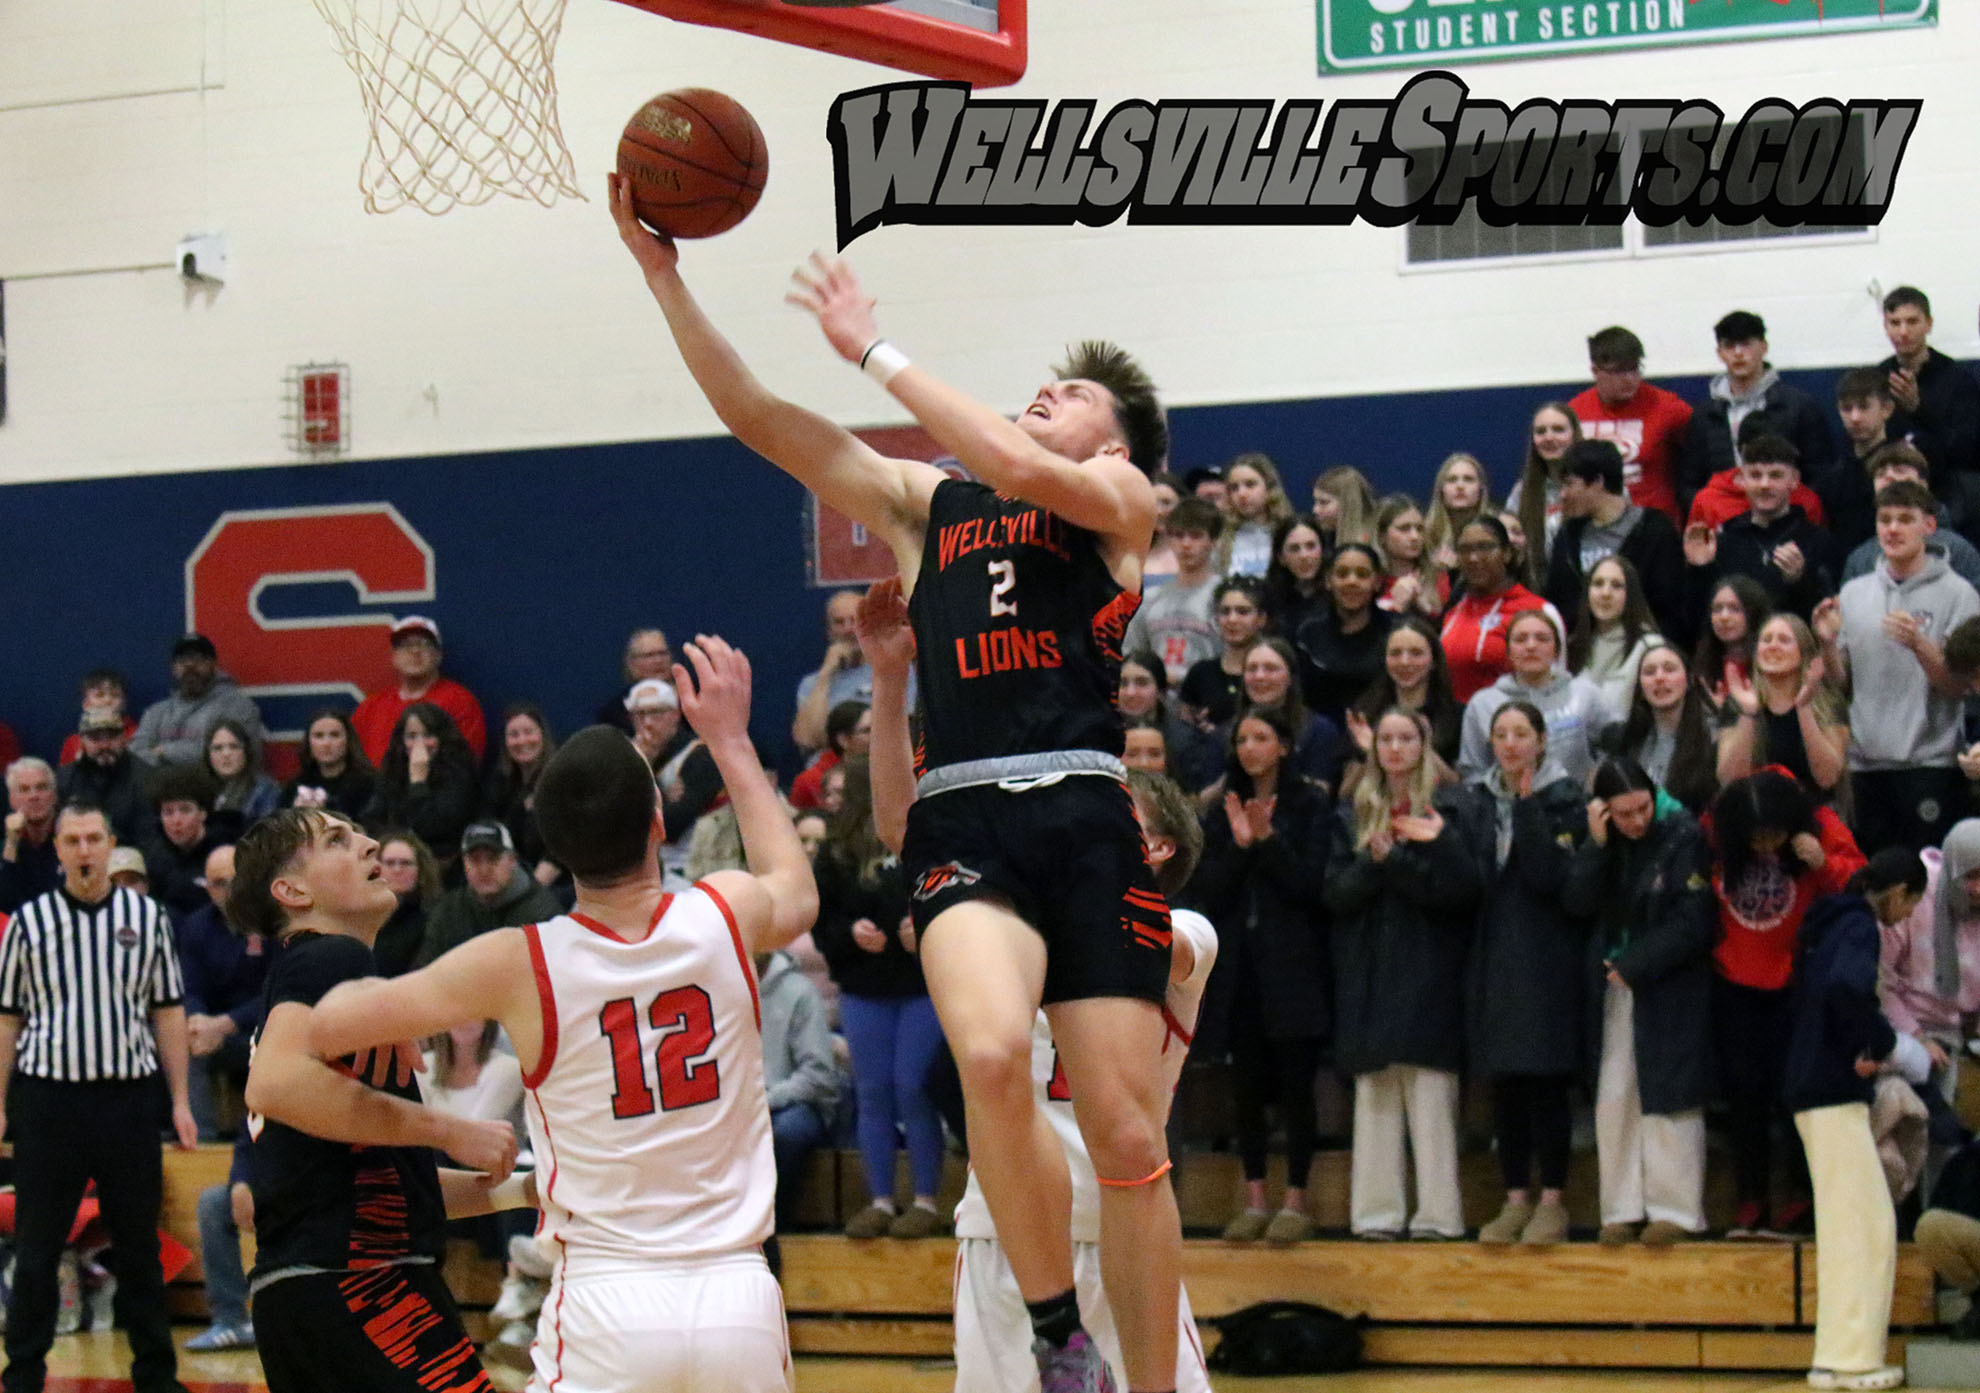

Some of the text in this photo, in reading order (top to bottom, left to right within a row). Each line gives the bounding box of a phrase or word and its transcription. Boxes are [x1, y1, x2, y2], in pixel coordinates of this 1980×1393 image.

[1370, 0, 1685, 54] STUDENT SECTION
[987, 559, 1018, 617] 2
[955, 626, 1063, 679] LIONS
[599, 983, 721, 1120] 12
